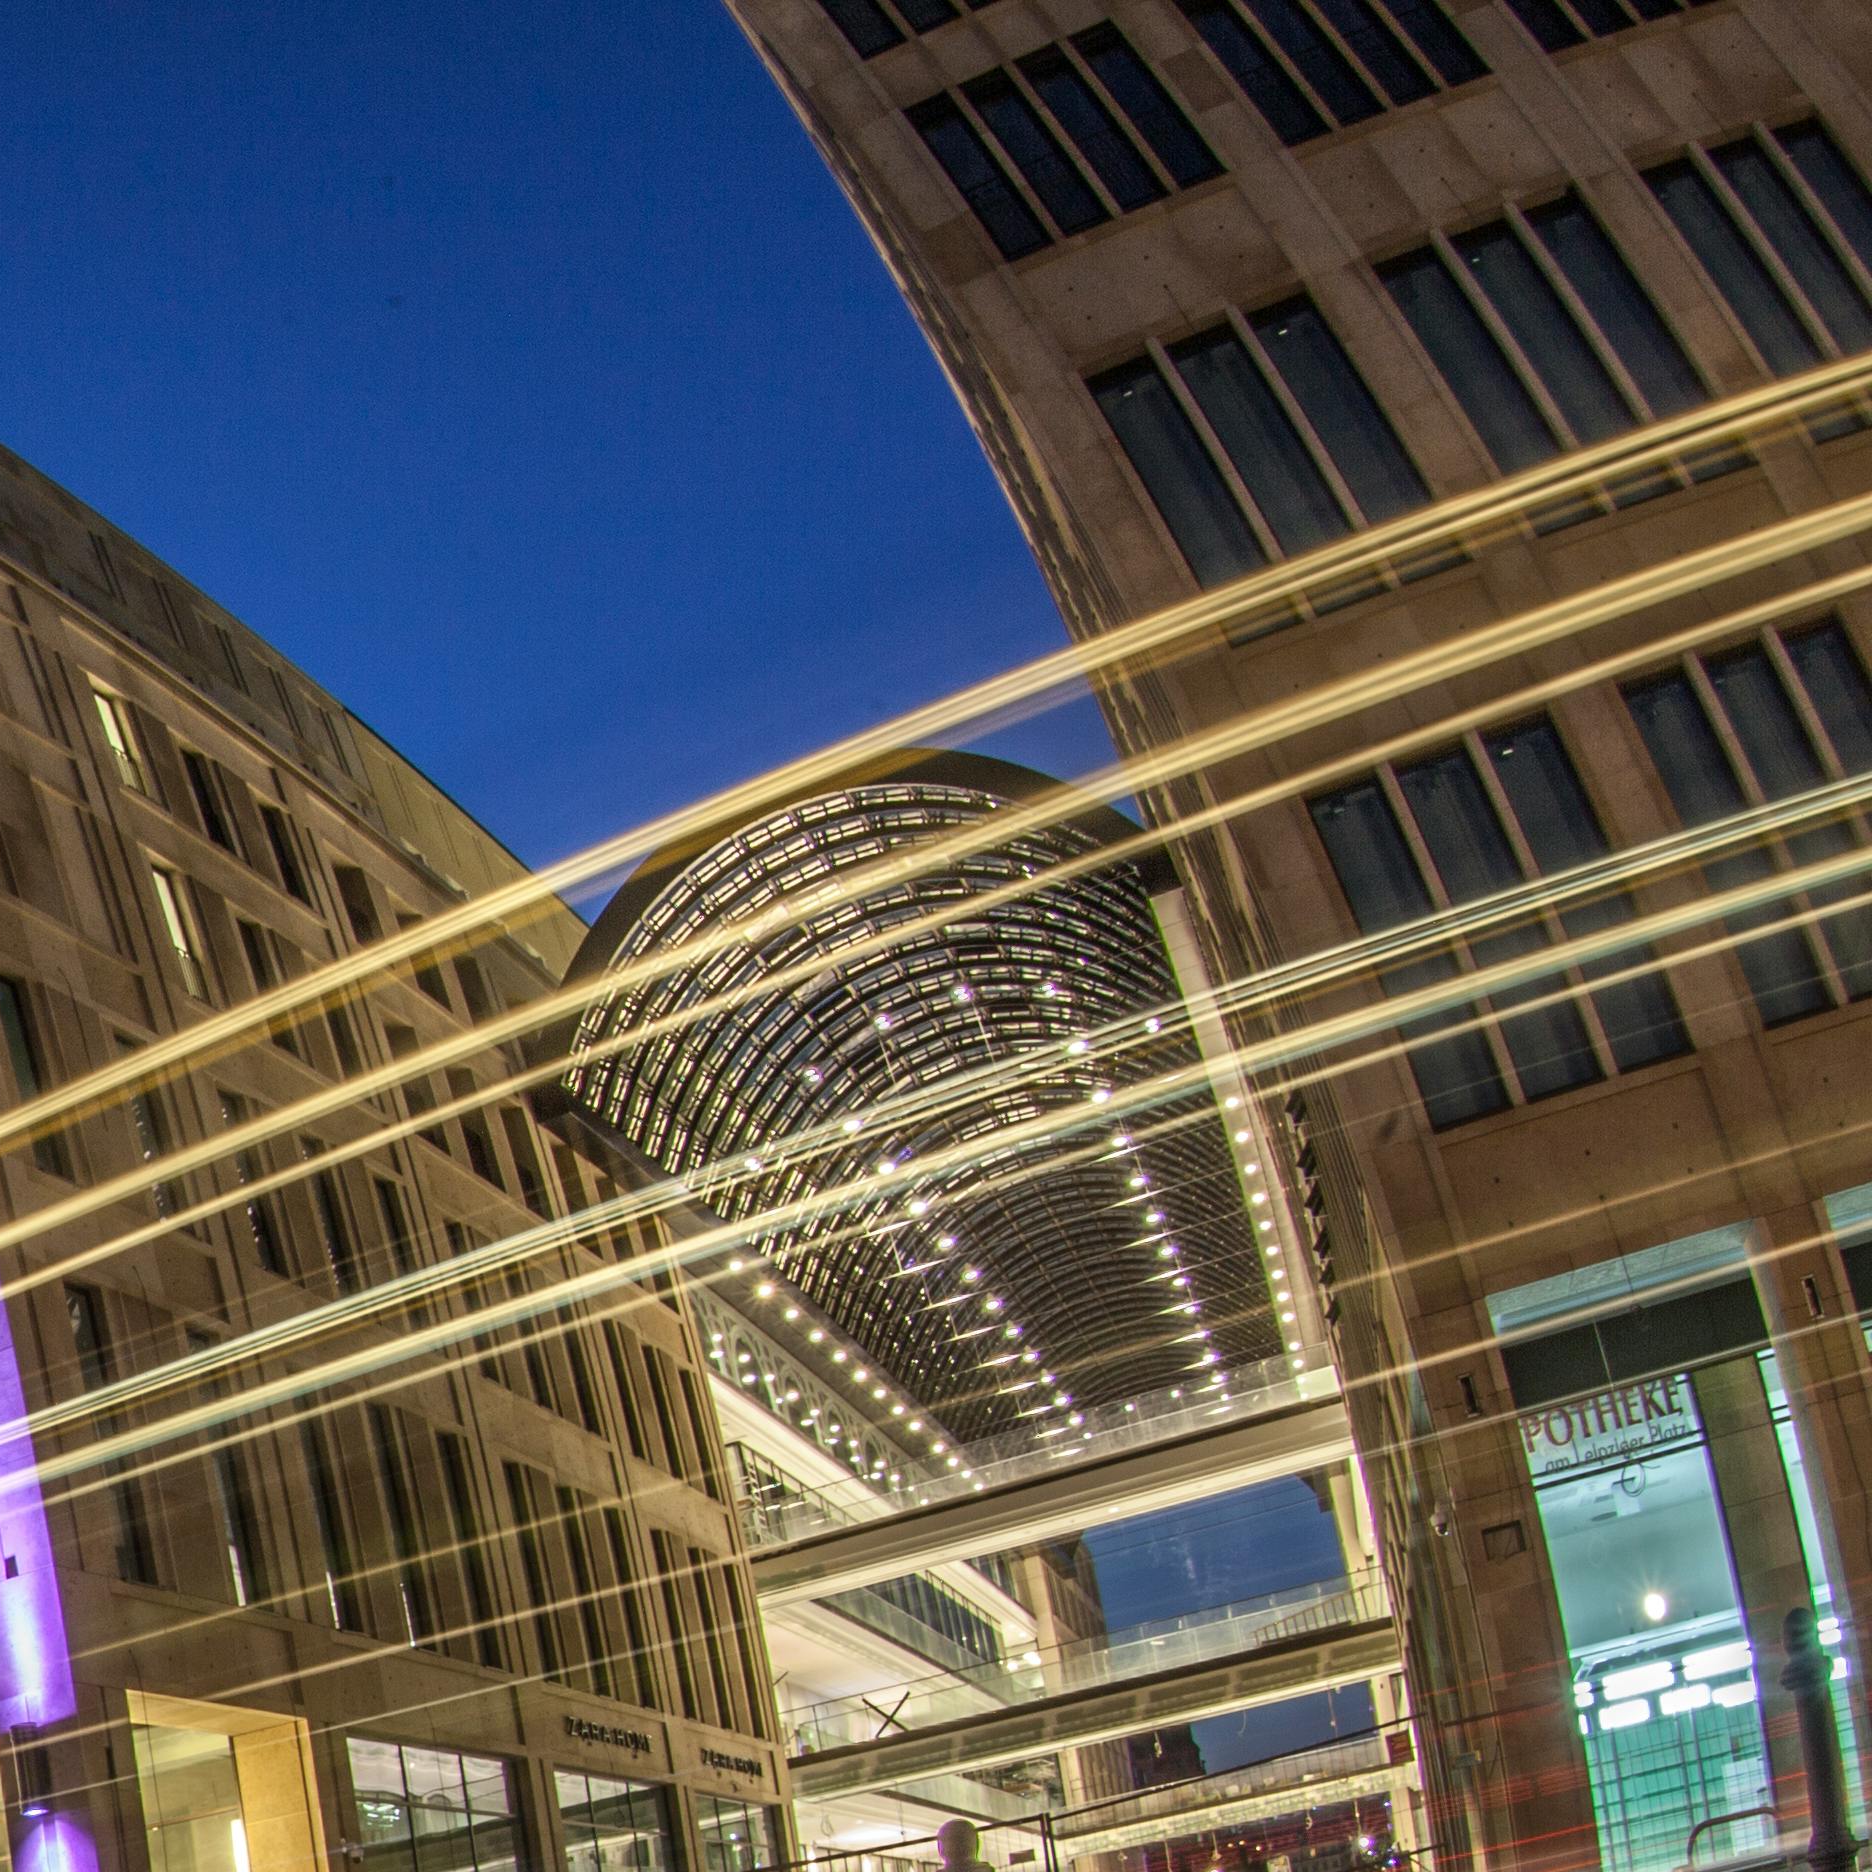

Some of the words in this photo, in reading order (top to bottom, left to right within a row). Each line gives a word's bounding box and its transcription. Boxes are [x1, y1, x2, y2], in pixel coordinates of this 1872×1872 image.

[1545, 1455, 1570, 1473] am
[1649, 1420, 1687, 1441] Platz
[564, 1715, 611, 1743] ZARA
